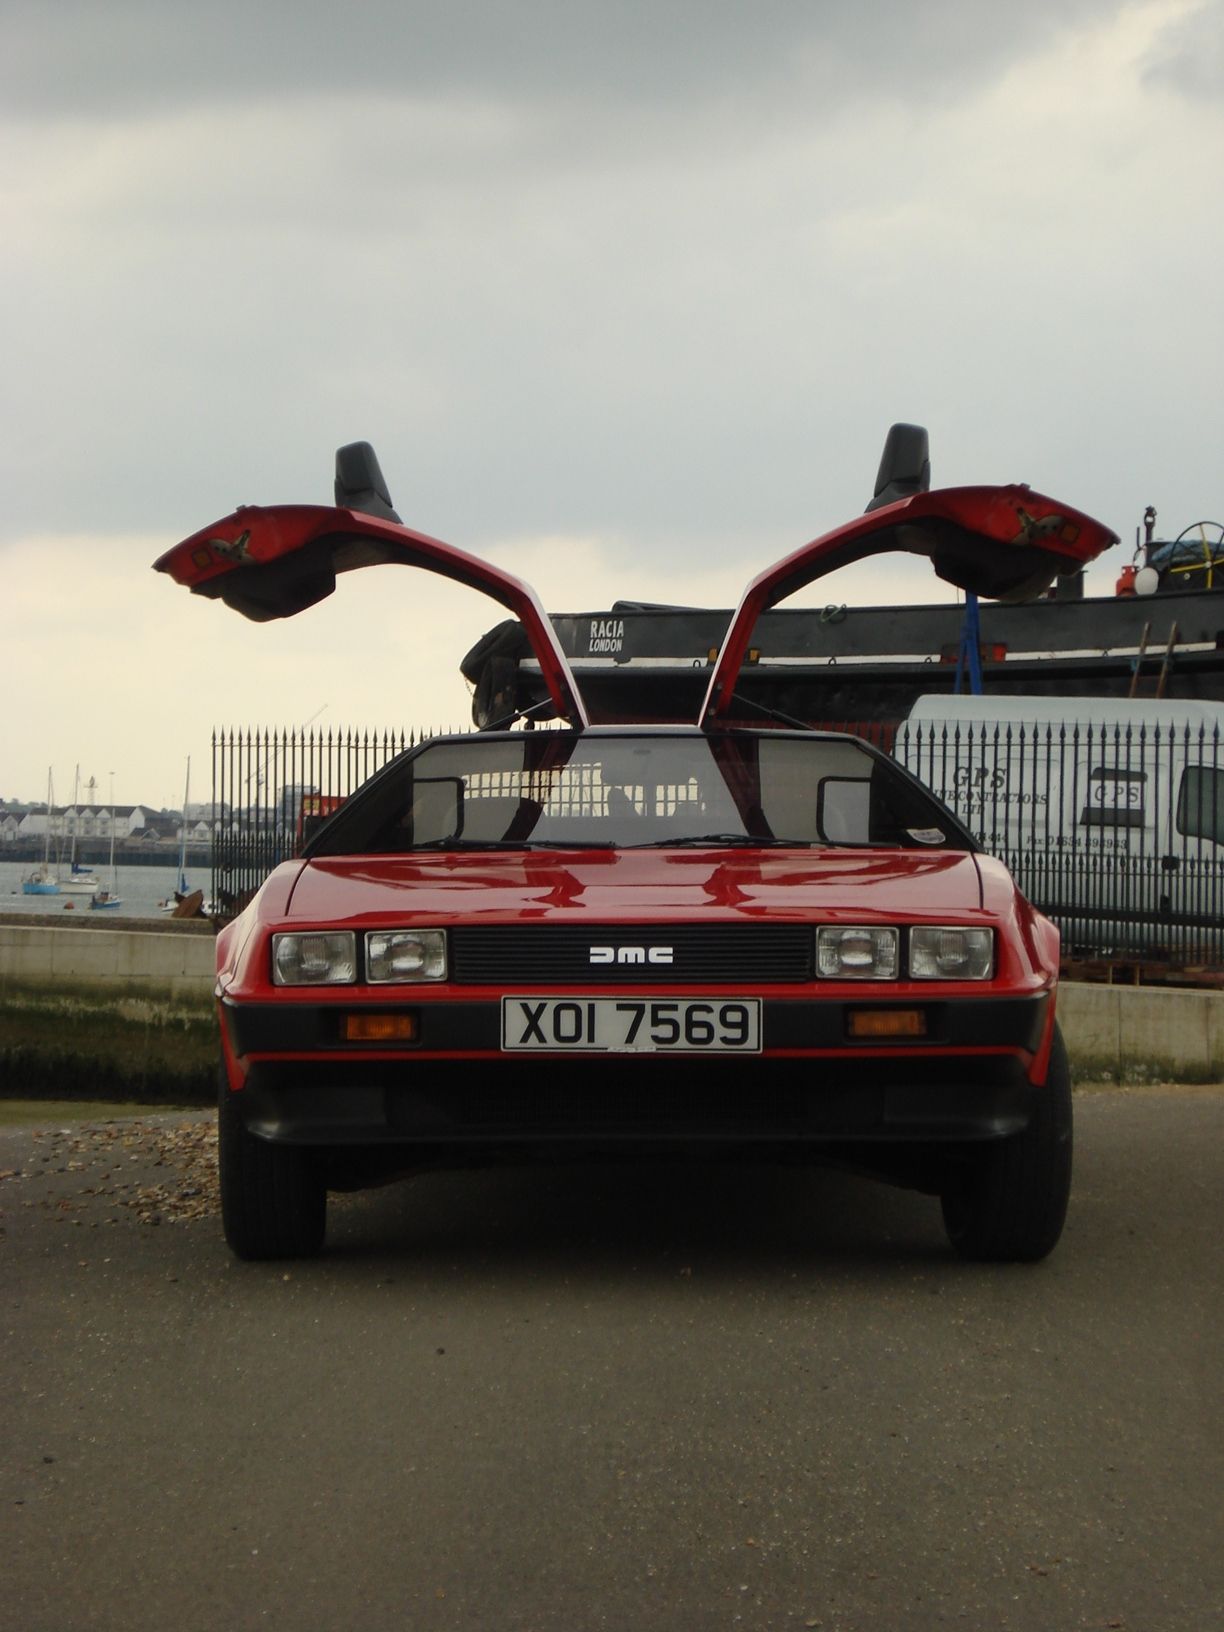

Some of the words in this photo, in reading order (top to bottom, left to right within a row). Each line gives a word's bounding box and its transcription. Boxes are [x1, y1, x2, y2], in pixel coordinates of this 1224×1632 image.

[590, 620, 624, 638] RACIA
[589, 639, 622, 652] LONDON
[953, 766, 1007, 788] GPS
[519, 1003, 595, 1044] XOI
[616, 1003, 749, 1045] 7569
